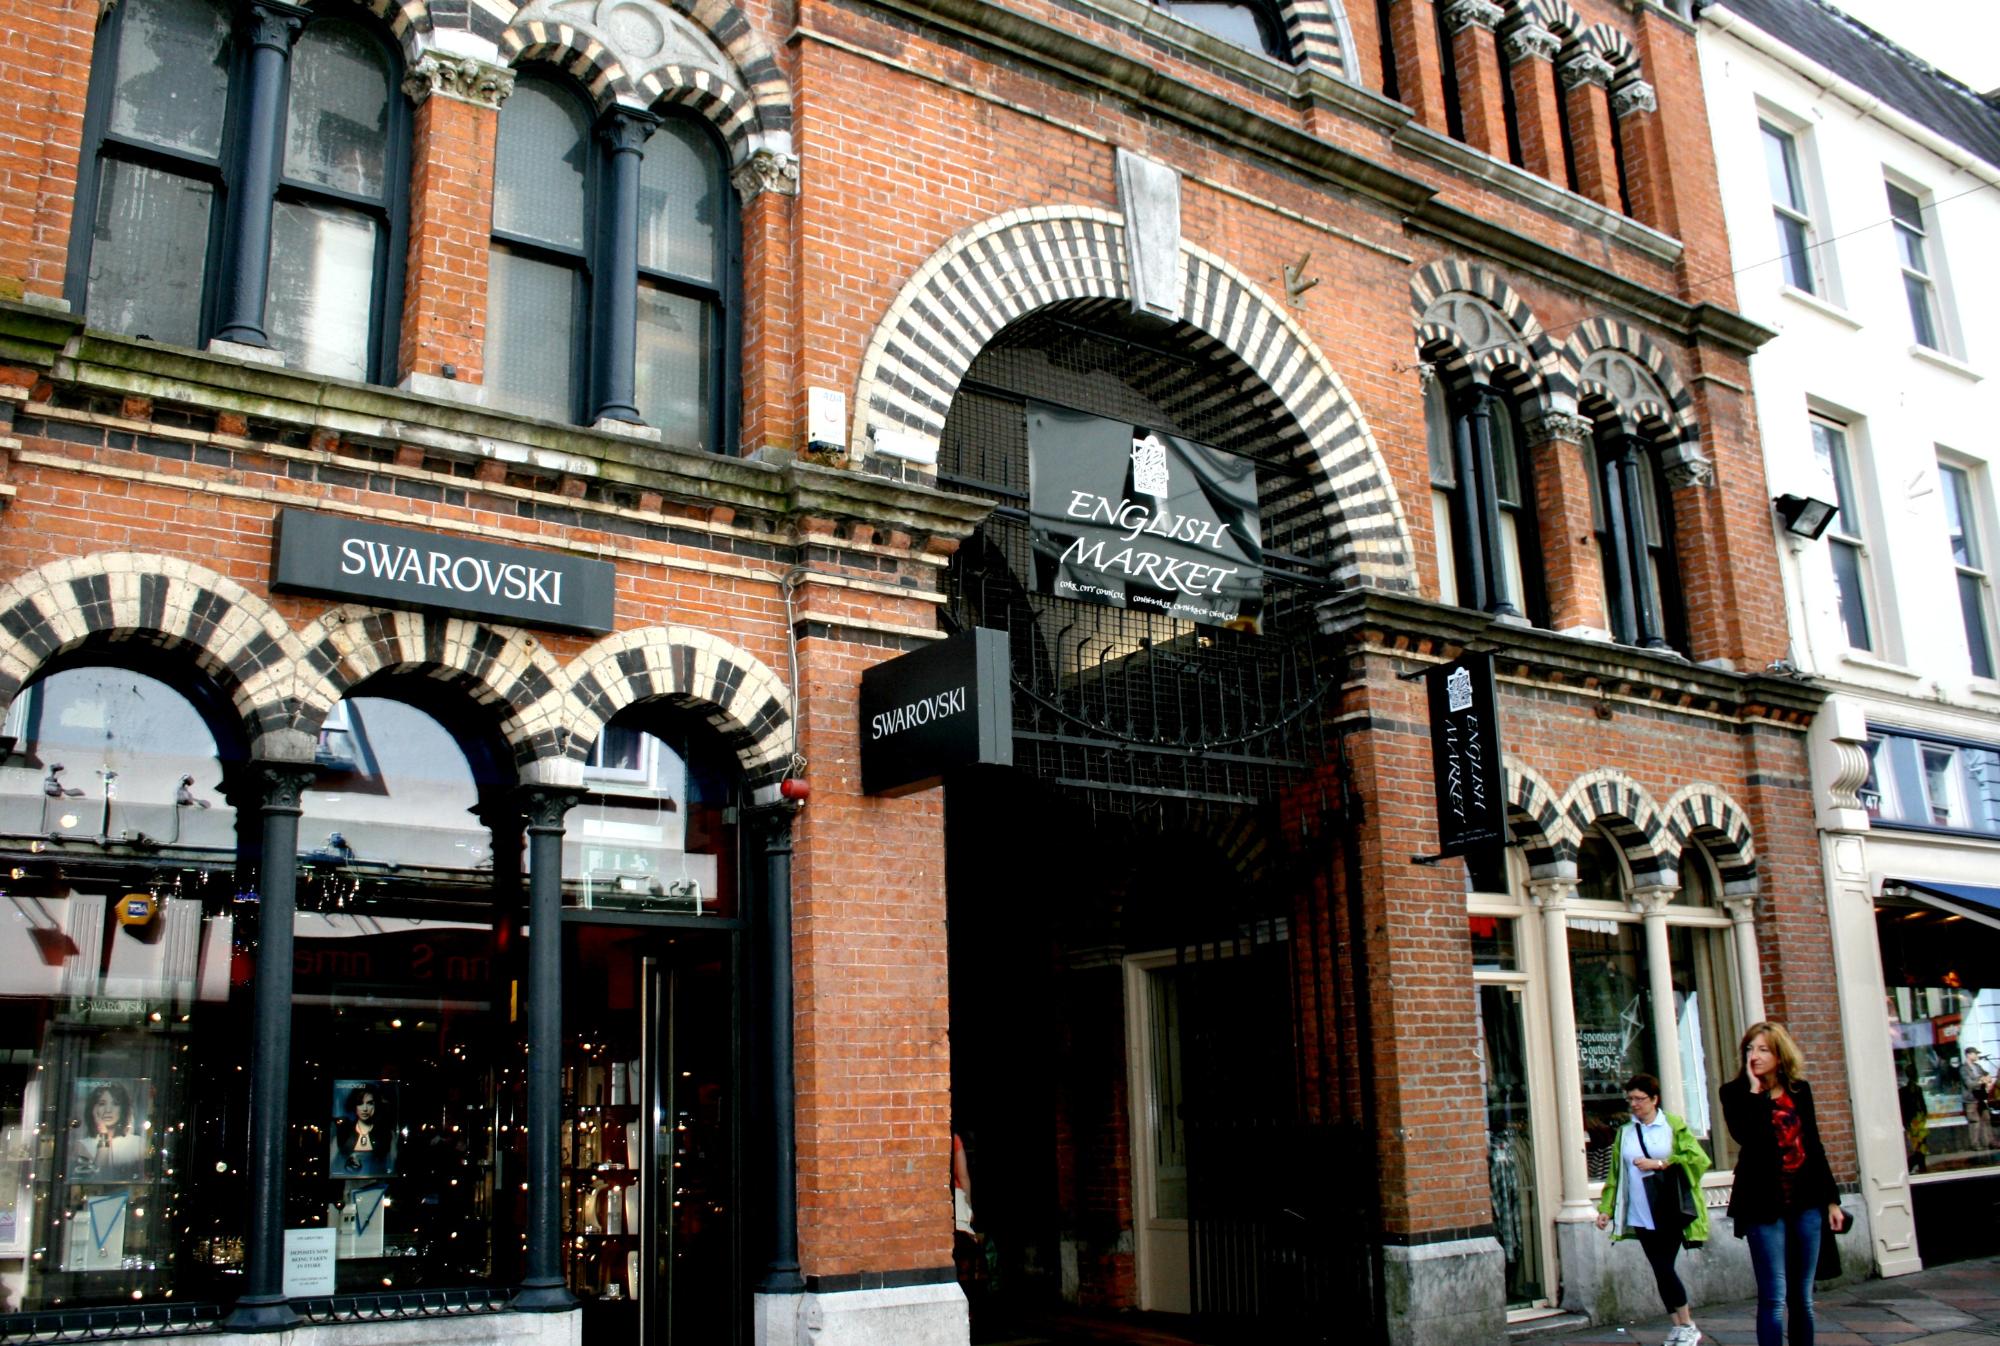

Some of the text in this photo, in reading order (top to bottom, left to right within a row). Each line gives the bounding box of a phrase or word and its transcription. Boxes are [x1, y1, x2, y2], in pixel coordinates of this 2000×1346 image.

[1067, 490, 1231, 549] ENGLISH
[341, 538, 563, 606] SWAROVSKI
[1060, 537, 1238, 596] MARKET
[872, 686, 966, 740] SWAROVSKI
[1445, 719, 1467, 824] MARKET
[1465, 714, 1486, 810] ENGLISH
[1865, 795, 1879, 810] 47
[1583, 1032, 1617, 1045] sponsors
[1588, 1043, 1617, 1055] outside
